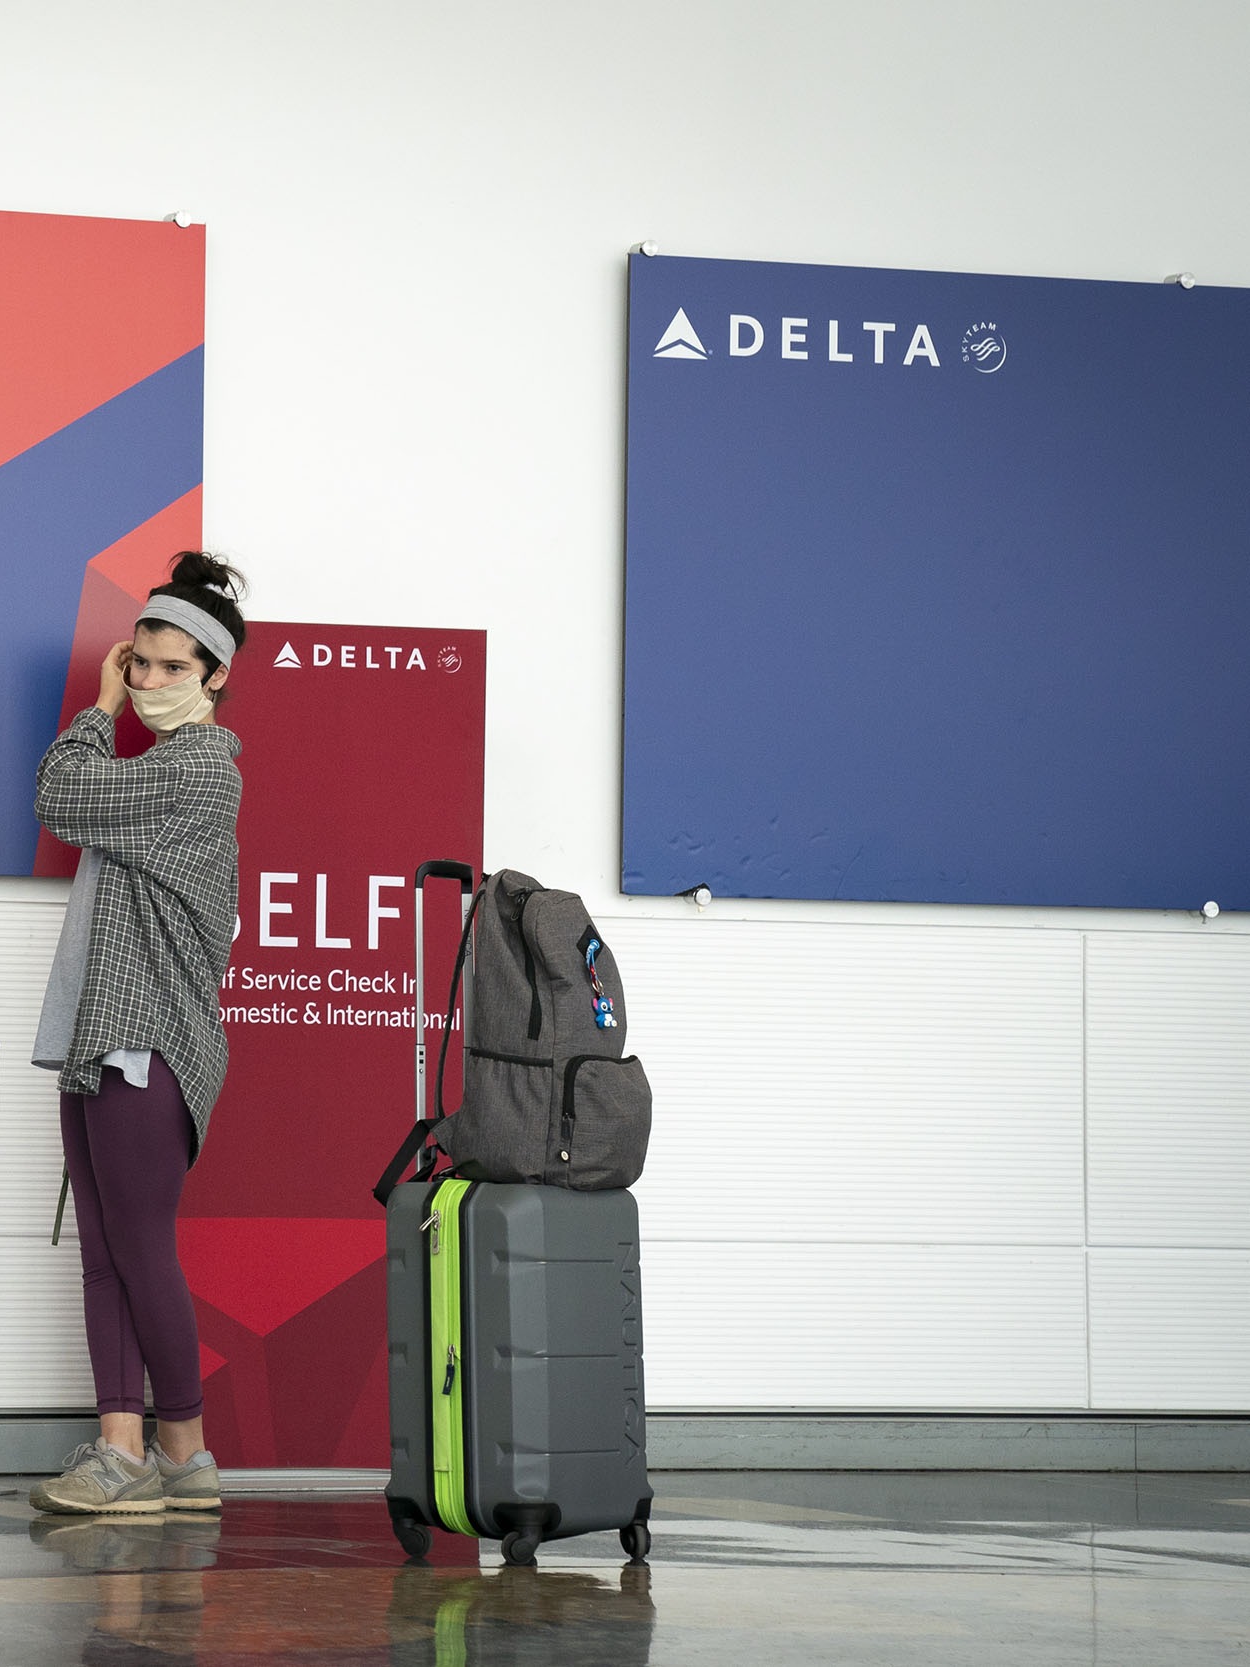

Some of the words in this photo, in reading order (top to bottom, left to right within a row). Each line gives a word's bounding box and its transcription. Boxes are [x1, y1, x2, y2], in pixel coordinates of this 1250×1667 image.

[728, 314, 942, 367] DELTA
[961, 321, 997, 362] SKYTEAM
[313, 644, 428, 671] DELTA
[232, 872, 406, 950] ELF
[241, 967, 321, 992] Service
[327, 969, 396, 994] Check
[219, 1002, 299, 1026] omestic
[303, 1002, 322, 1026] &
